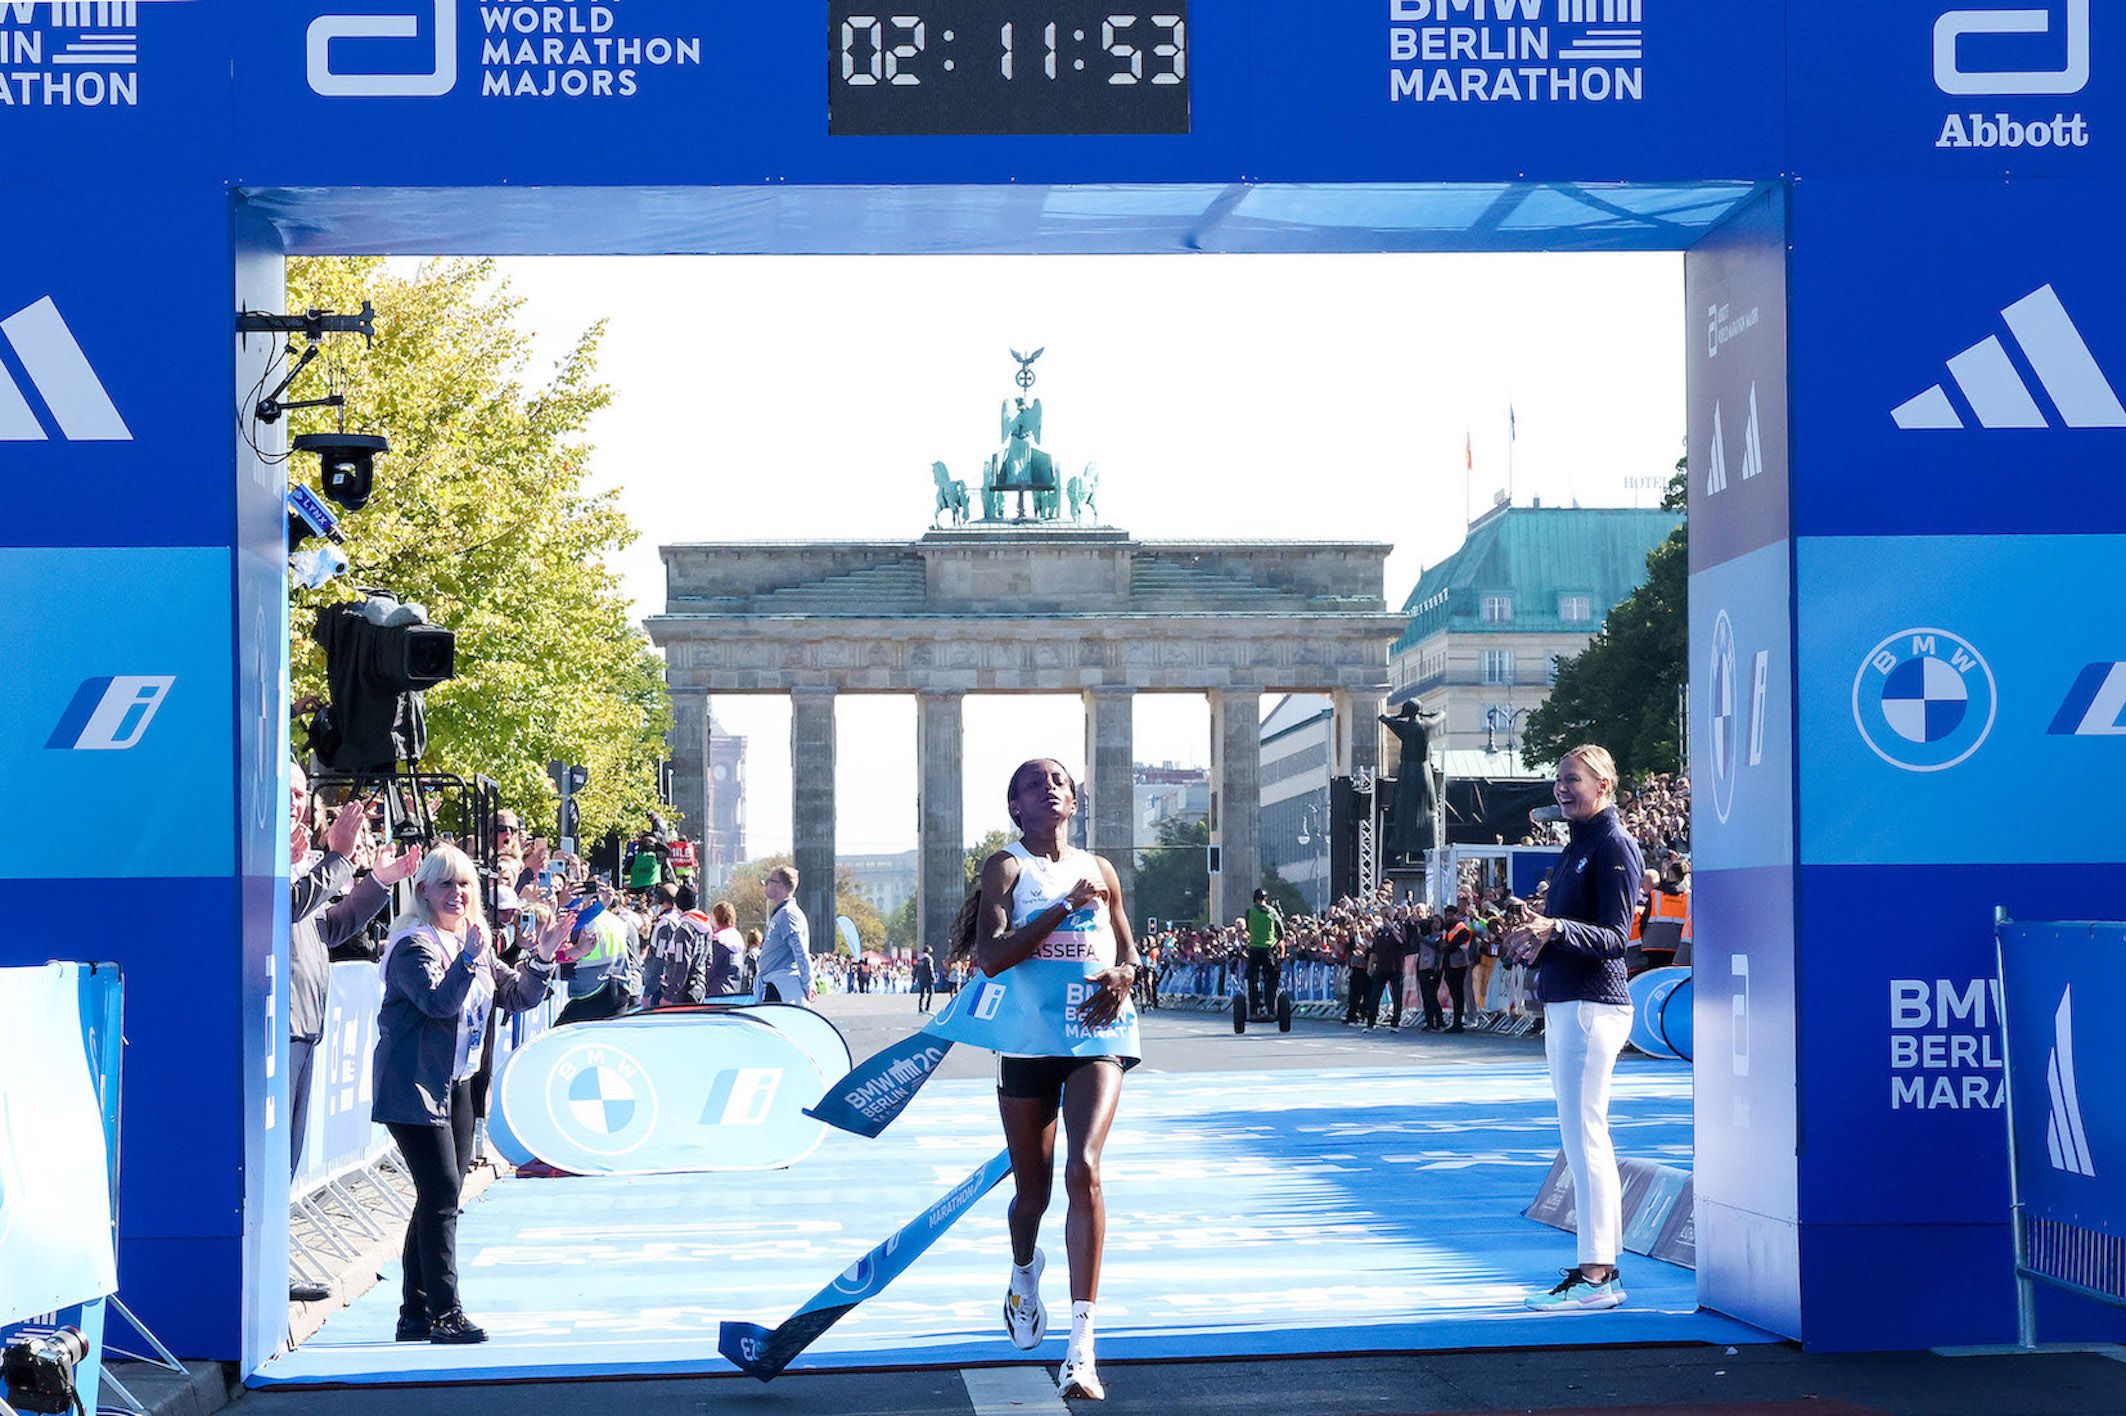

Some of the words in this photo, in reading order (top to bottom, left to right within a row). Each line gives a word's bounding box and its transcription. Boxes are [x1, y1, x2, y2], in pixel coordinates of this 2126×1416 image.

[480, 6, 614, 34] WORLD
[481, 37, 700, 65] MARATHON
[1390, 26, 1549, 61] BERLIN
[481, 68, 638, 97] MAJORS
[1390, 66, 1643, 102] MARATHON
[1935, 112, 2089, 148] Abbott
[302, 498, 328, 525] LYNX
[1871, 635, 1978, 676] BMW
[558, 1048, 637, 1082] BMW
[844, 1071, 897, 1110] BMW
[860, 1087, 909, 1118] BERLIN
[928, 1184, 976, 1229] MARATHON
